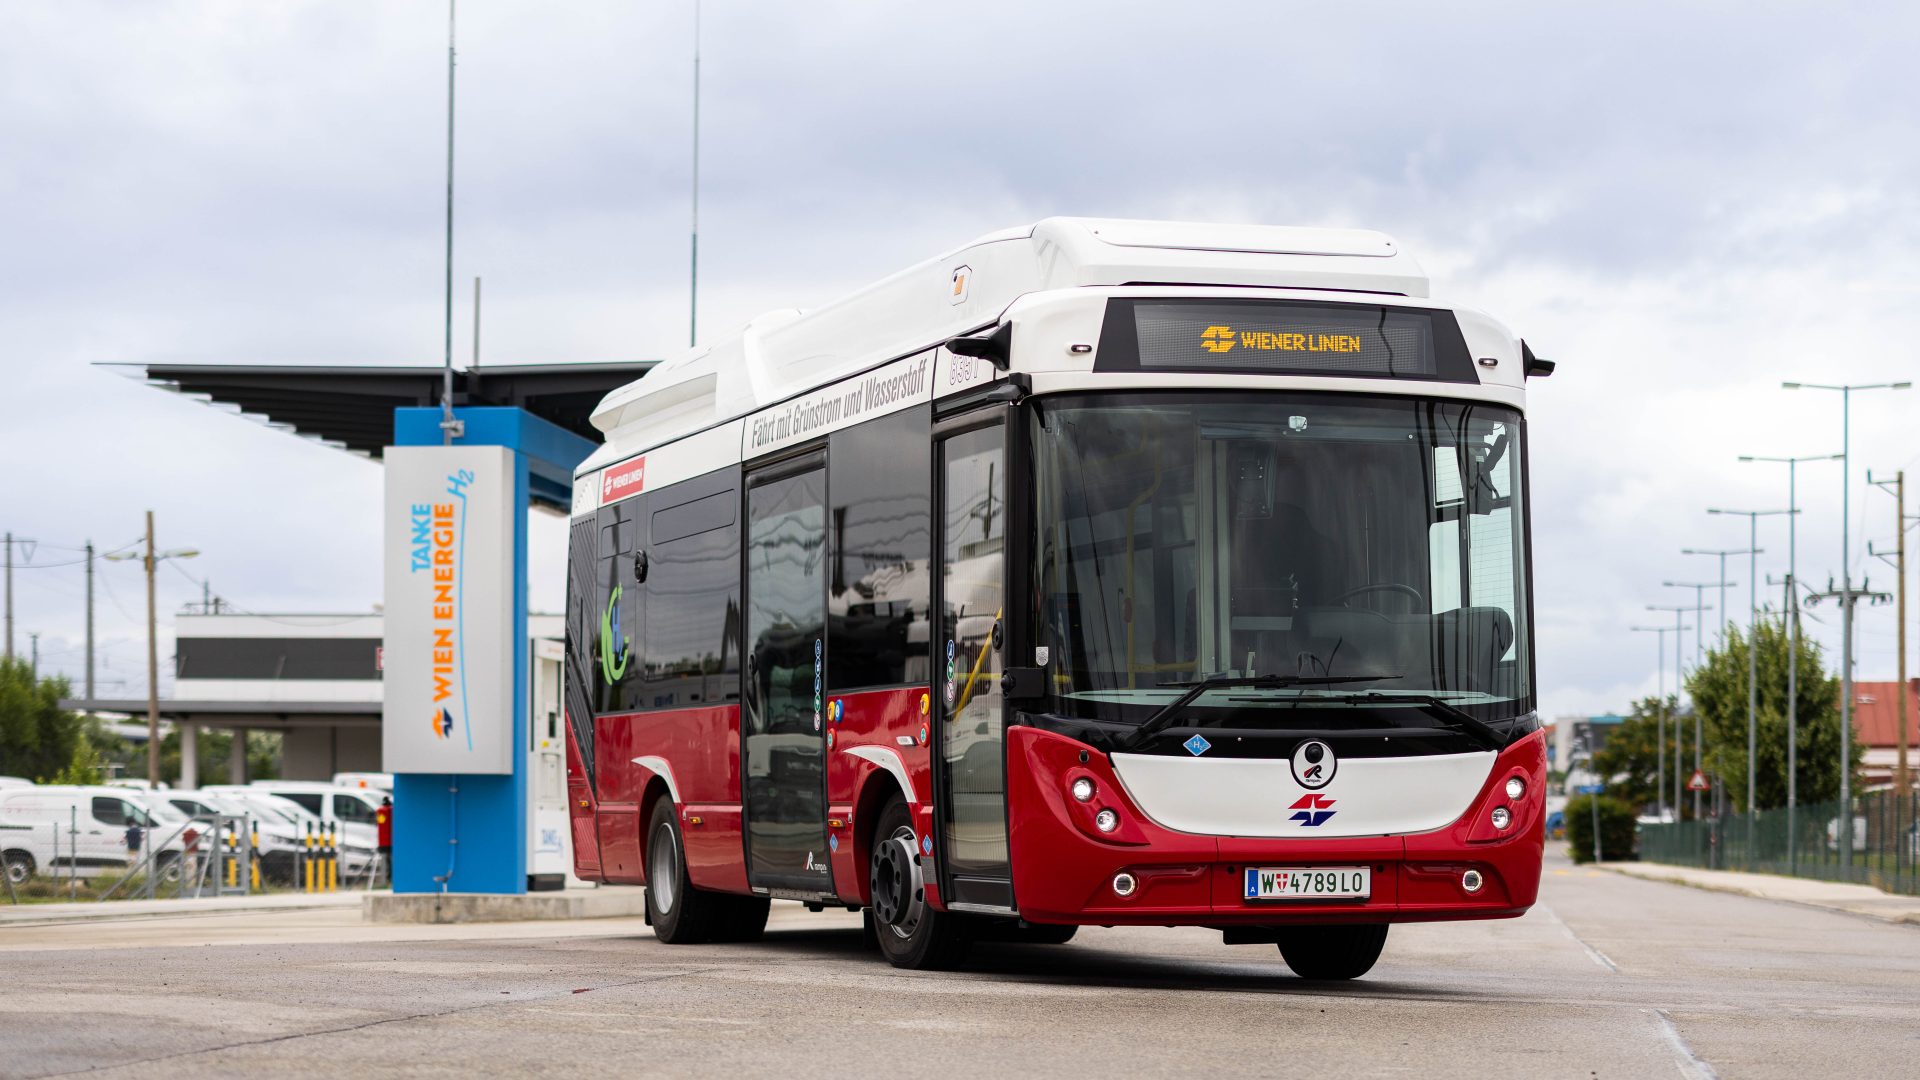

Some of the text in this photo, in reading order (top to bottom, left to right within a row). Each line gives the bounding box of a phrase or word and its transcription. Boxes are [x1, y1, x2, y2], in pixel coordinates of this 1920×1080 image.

[1241, 331, 1361, 353] WIENER LINIEN
[752, 358, 928, 449] Fährt mit Grünstrom und Wasserstoff
[411, 504, 432, 573] TANKE
[432, 504, 455, 703] WIEN ENERGIE
[1262, 873, 1275, 893] W
[1290, 872, 1337, 893] 4789
